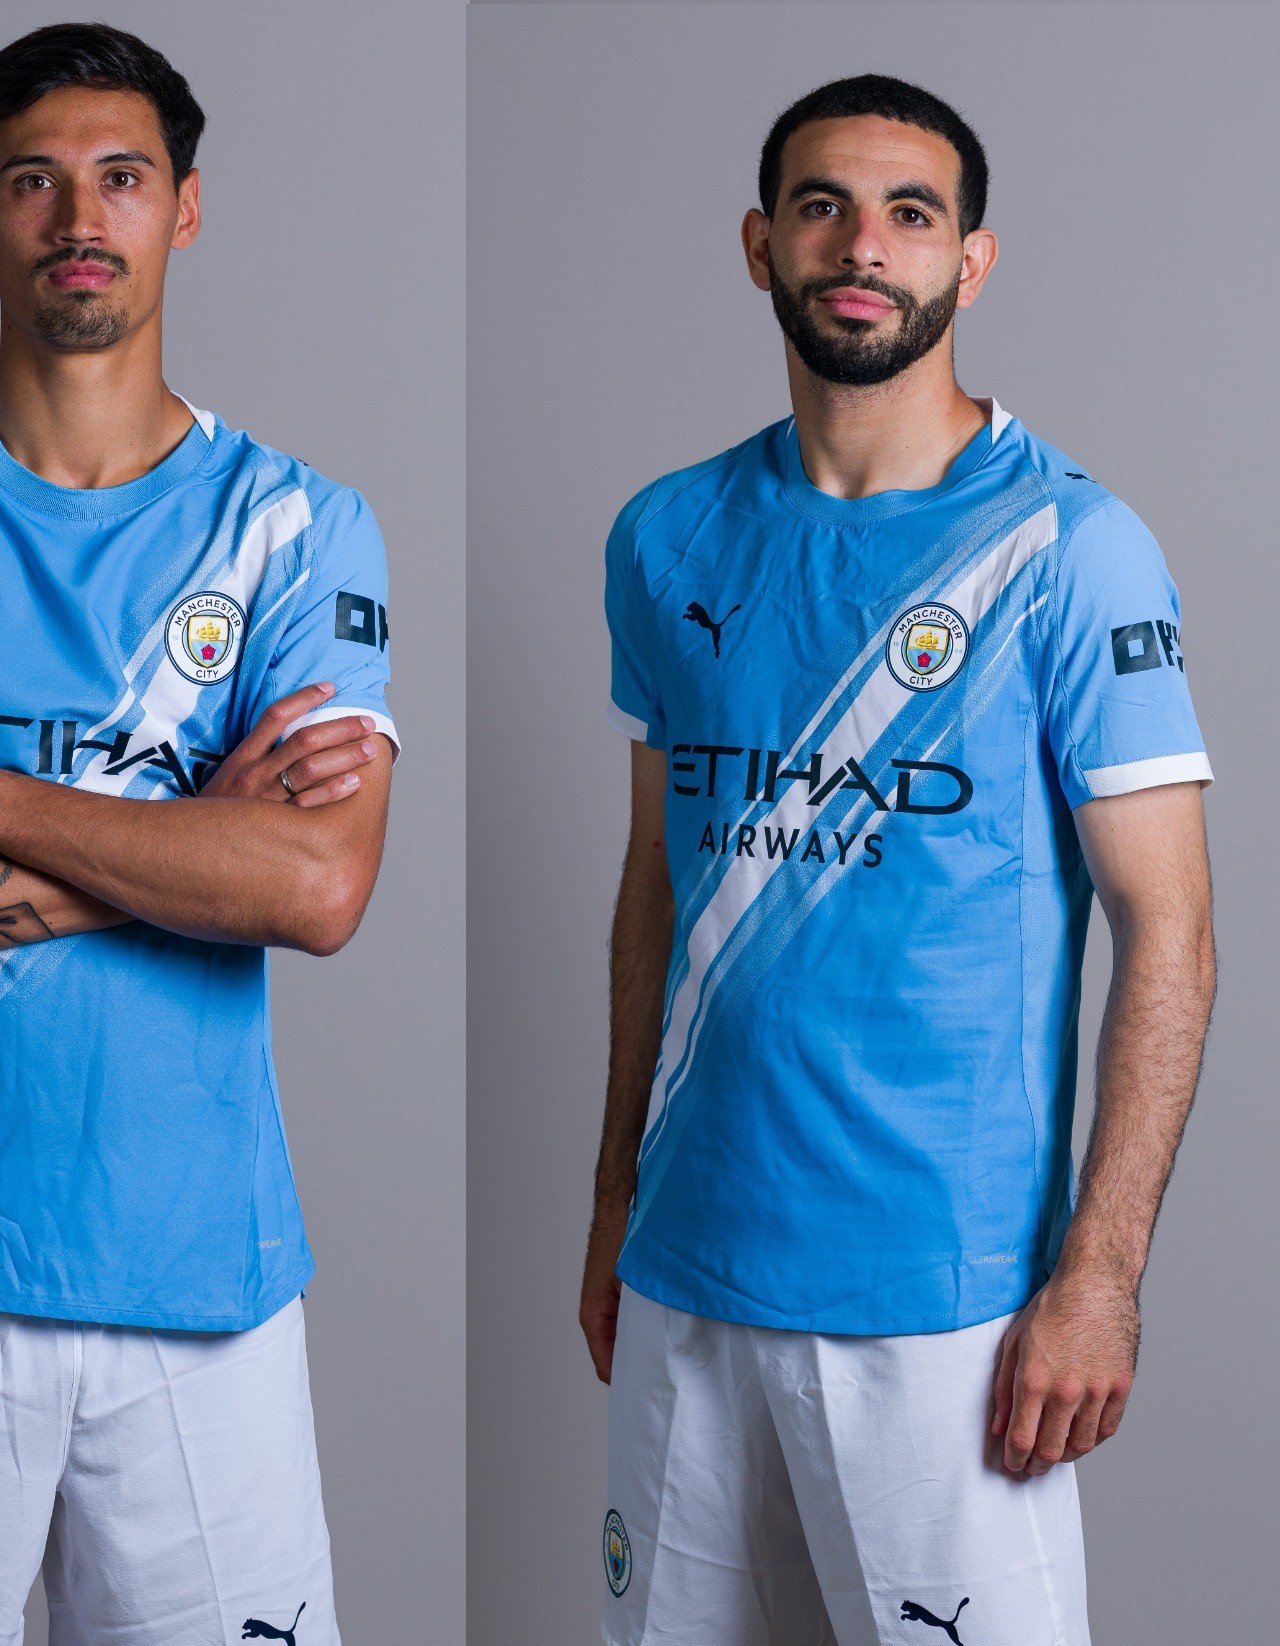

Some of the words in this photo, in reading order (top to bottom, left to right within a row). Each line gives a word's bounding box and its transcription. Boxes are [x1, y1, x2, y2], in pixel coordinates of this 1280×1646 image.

[174, 598, 241, 628] MANCHESTER
[898, 609, 963, 639] MANCHESTER
[195, 669, 219, 679] CITY
[909, 676, 933, 685] CITY
[671, 743, 974, 816] ETIHAD
[696, 820, 883, 869] AIRWAYS
[258, 1238, 283, 1248] WEAVE
